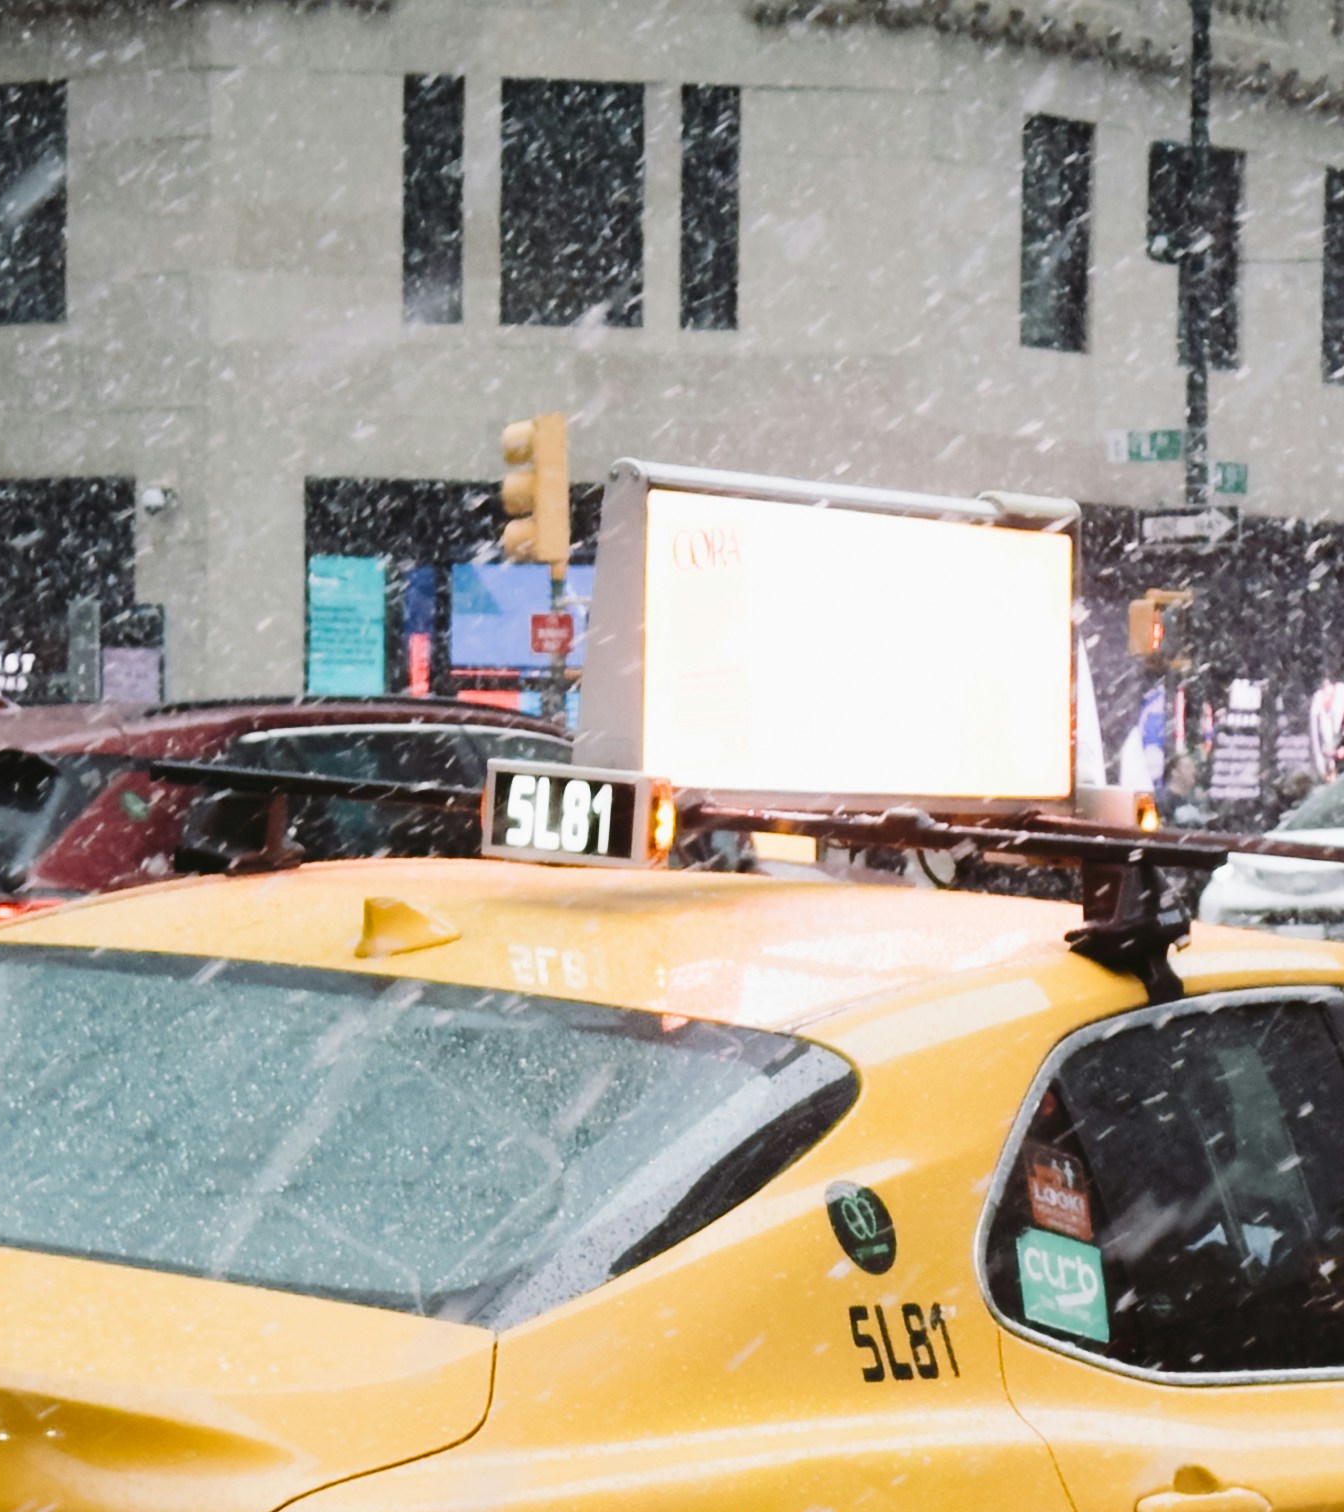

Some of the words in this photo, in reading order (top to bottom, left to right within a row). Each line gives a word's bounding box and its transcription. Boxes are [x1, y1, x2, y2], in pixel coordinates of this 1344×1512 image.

[505, 774, 613, 855] 5L81
[1023, 1246, 1099, 1308] curb
[849, 1302, 960, 1383] 5L81
